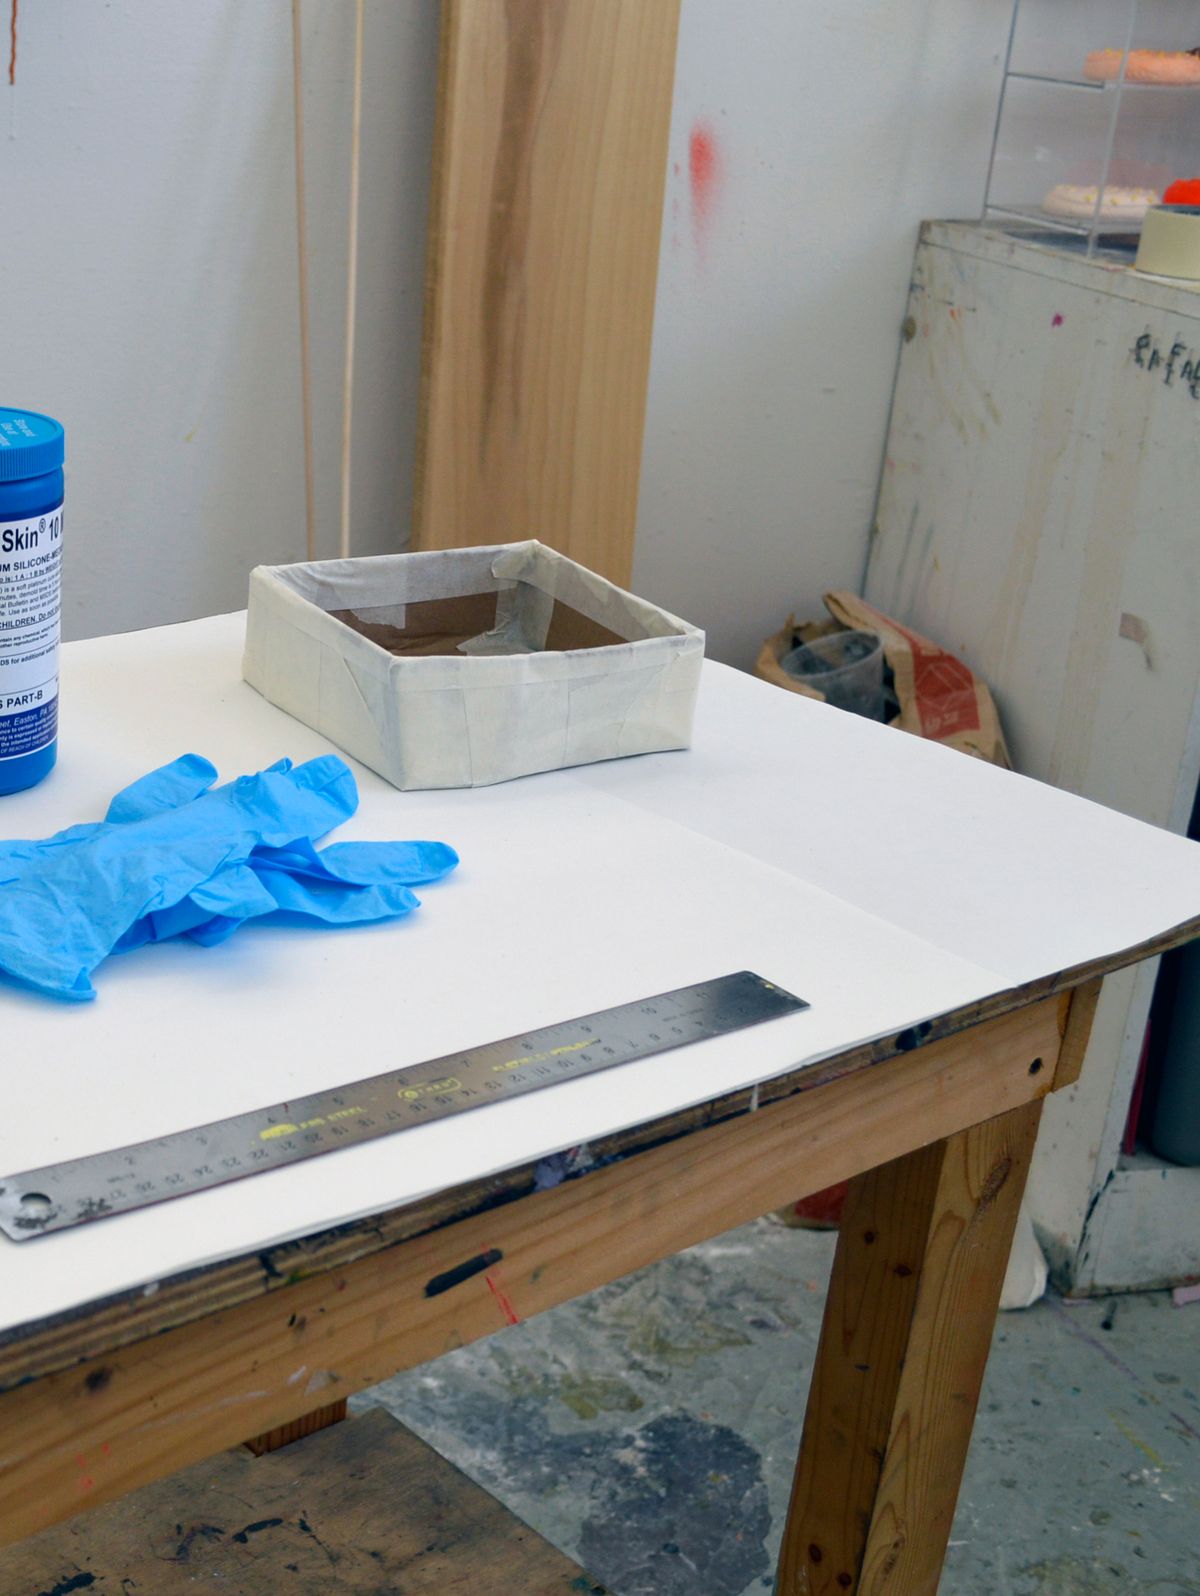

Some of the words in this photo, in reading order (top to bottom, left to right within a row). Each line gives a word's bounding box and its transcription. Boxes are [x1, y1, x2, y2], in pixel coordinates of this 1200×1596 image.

[49, 516, 59, 541] 10
[21, 651, 45, 662] additional
[7, 690, 43, 708] PART-B
